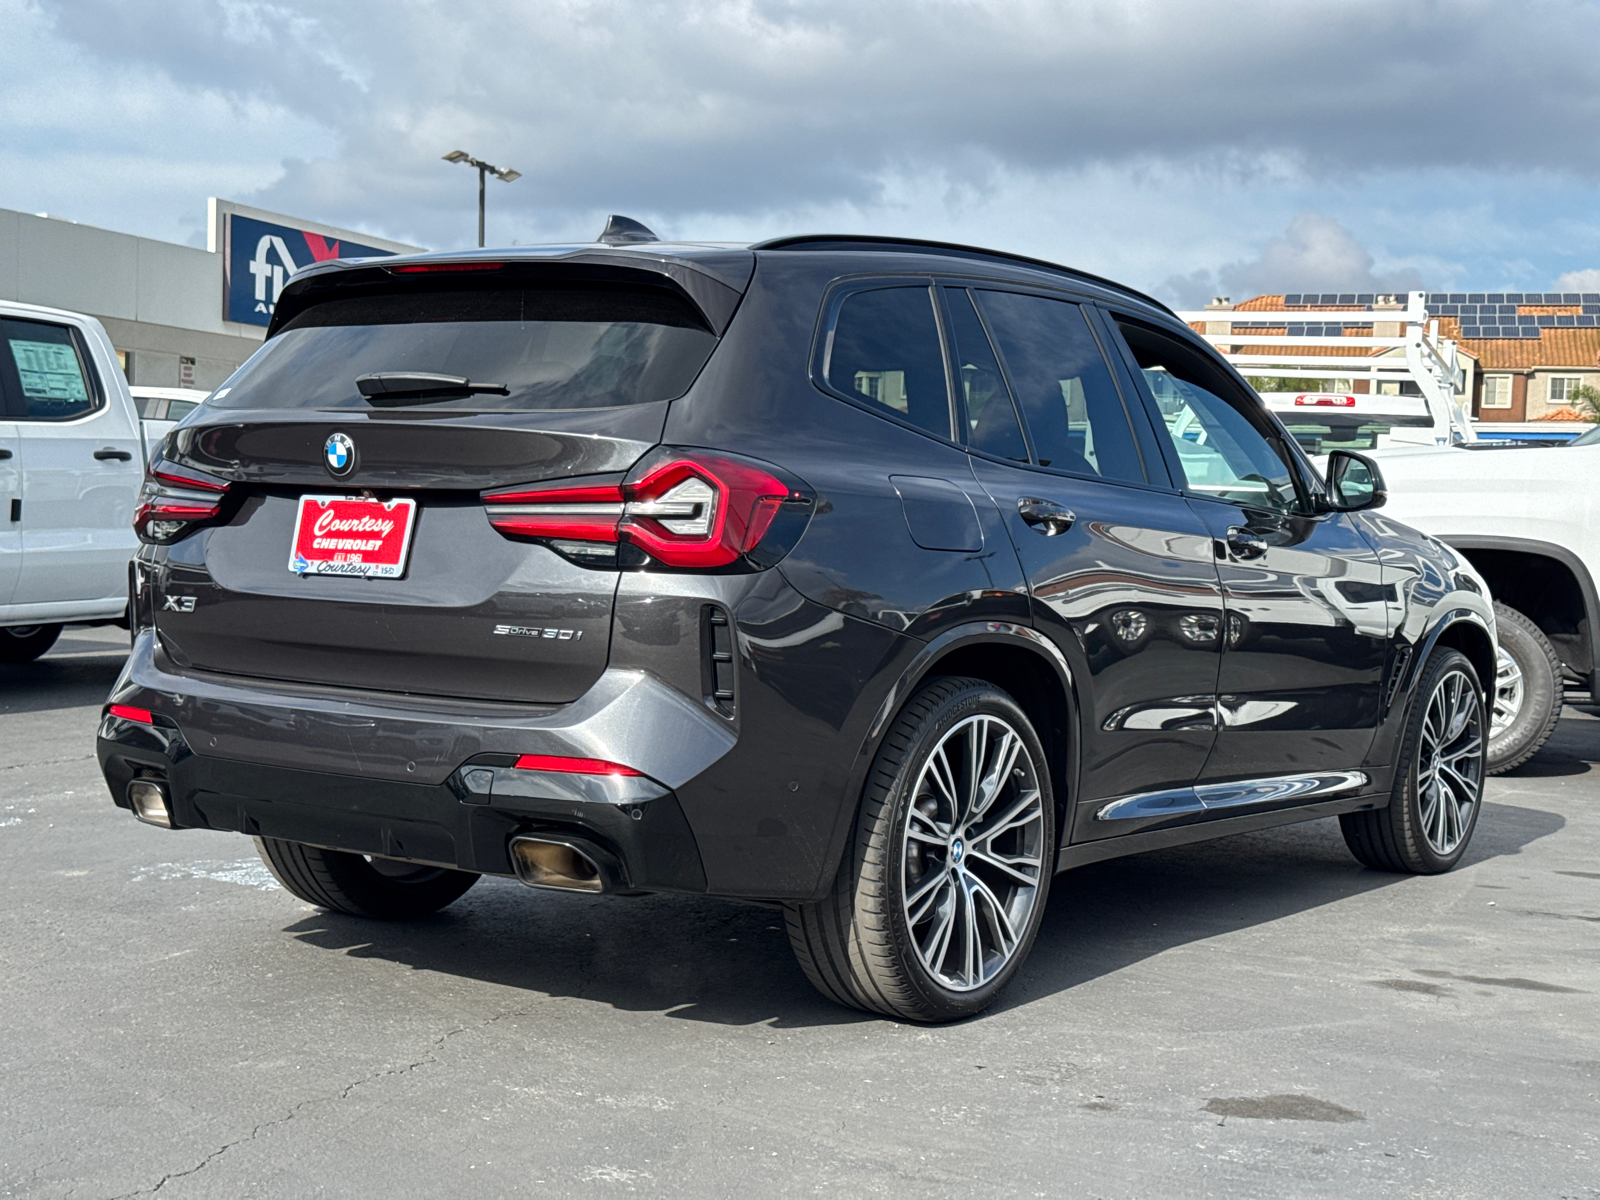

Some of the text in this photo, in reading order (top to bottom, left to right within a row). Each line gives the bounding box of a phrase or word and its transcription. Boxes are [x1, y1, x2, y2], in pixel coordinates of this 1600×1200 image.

[325, 435, 351, 450] BMW
[313, 509, 394, 538] Courtesy
[312, 537, 383, 551] CHEVROLET
[346, 553, 363, 563] 1961
[316, 560, 371, 578] Courtesy
[162, 595, 198, 612] X3
